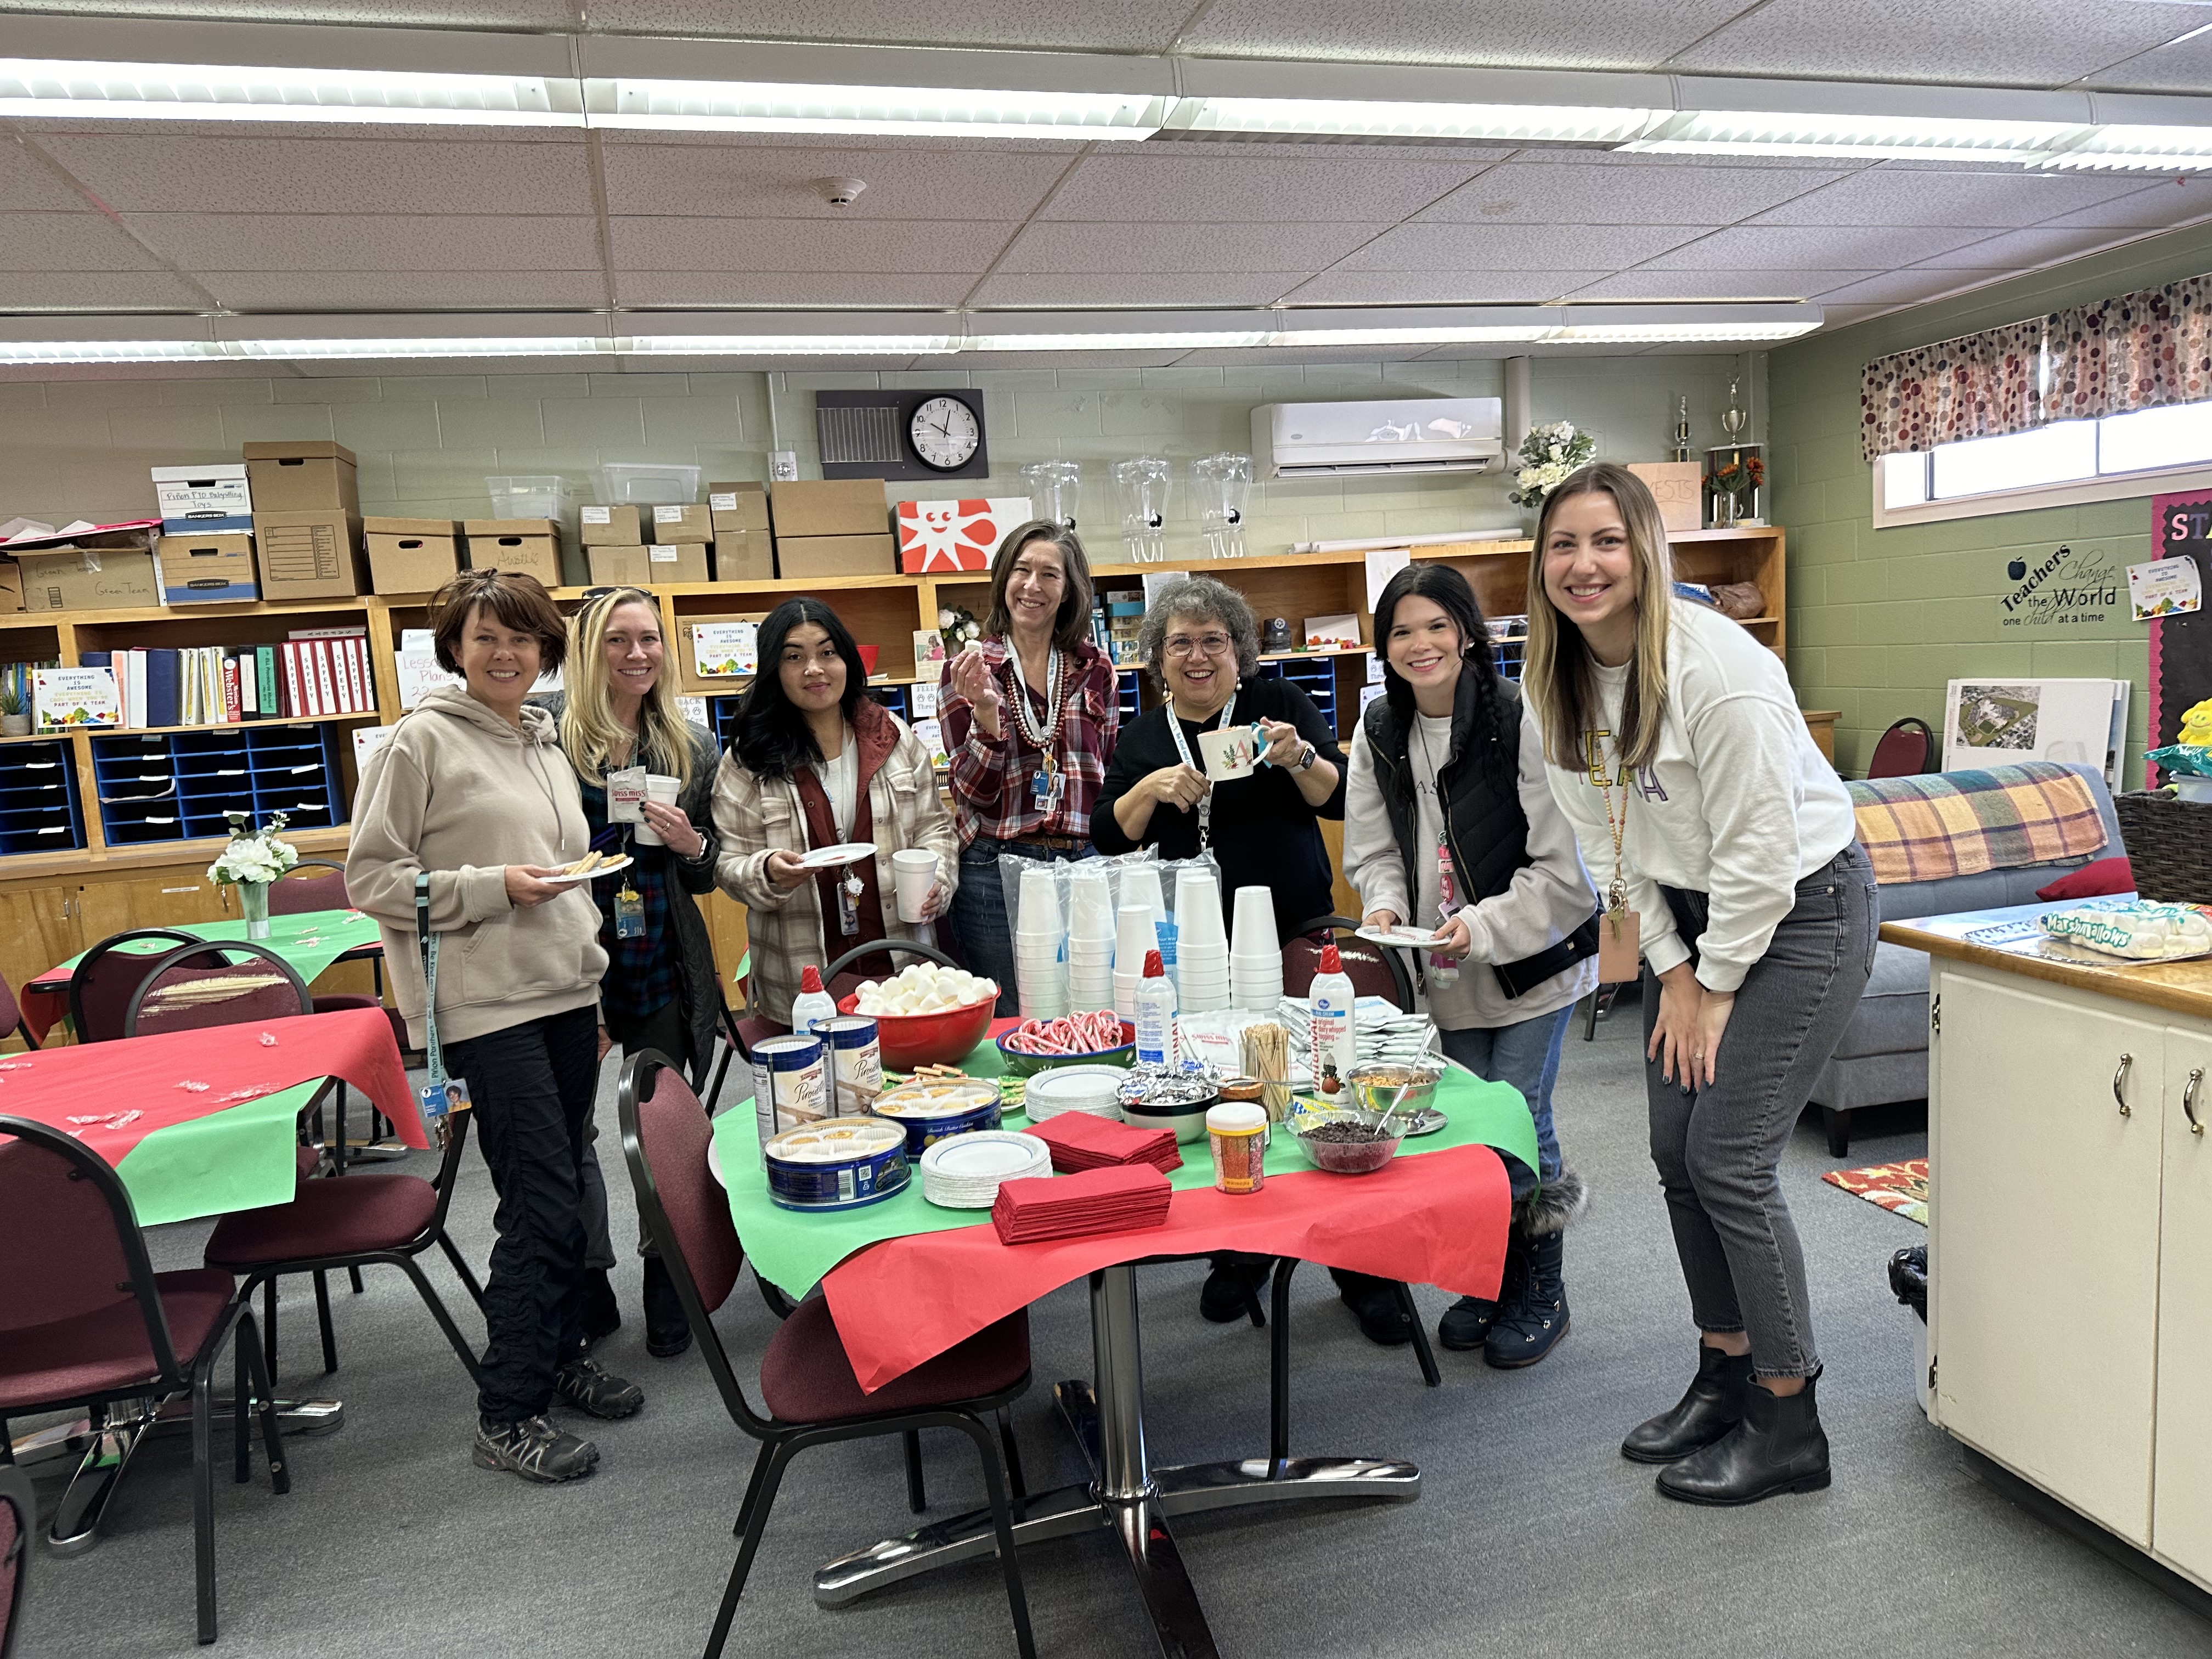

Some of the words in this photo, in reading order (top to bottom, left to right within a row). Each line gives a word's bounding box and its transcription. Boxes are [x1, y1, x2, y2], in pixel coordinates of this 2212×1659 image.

[970, 428, 974, 436] 3
[920, 444, 926, 452] 8
[190, 500, 212, 509] Toys
[2171, 514, 2212, 540] ST
[36, 561, 62, 578] Green
[2059, 549, 2116, 585] Change
[95, 581, 122, 596] Green
[122, 582, 150, 594] Team
[2000, 544, 2070, 613] Teachers
[2028, 595, 2047, 607] the
[2053, 586, 2117, 606] World
[2023, 607, 2056, 625] child
[2058, 614, 2069, 624] at
[2081, 613, 2105, 623] time
[403, 657, 439, 669] Lesso
[289, 659, 297, 699] SAFETY
[304, 658, 314, 698] SAFETY
[320, 656, 329, 697] SAFETY
[336, 654, 346, 698] SAFETY
[351, 654, 359, 695] SAFETY
[420, 670, 455, 682] Plans
[225, 670, 235, 711] Webster's
[1178, 738, 1187, 751] Kind
[1233, 740, 1250, 764] A
[2046, 912, 2130, 947] Marshmallows
[430, 951, 437, 960] Be
